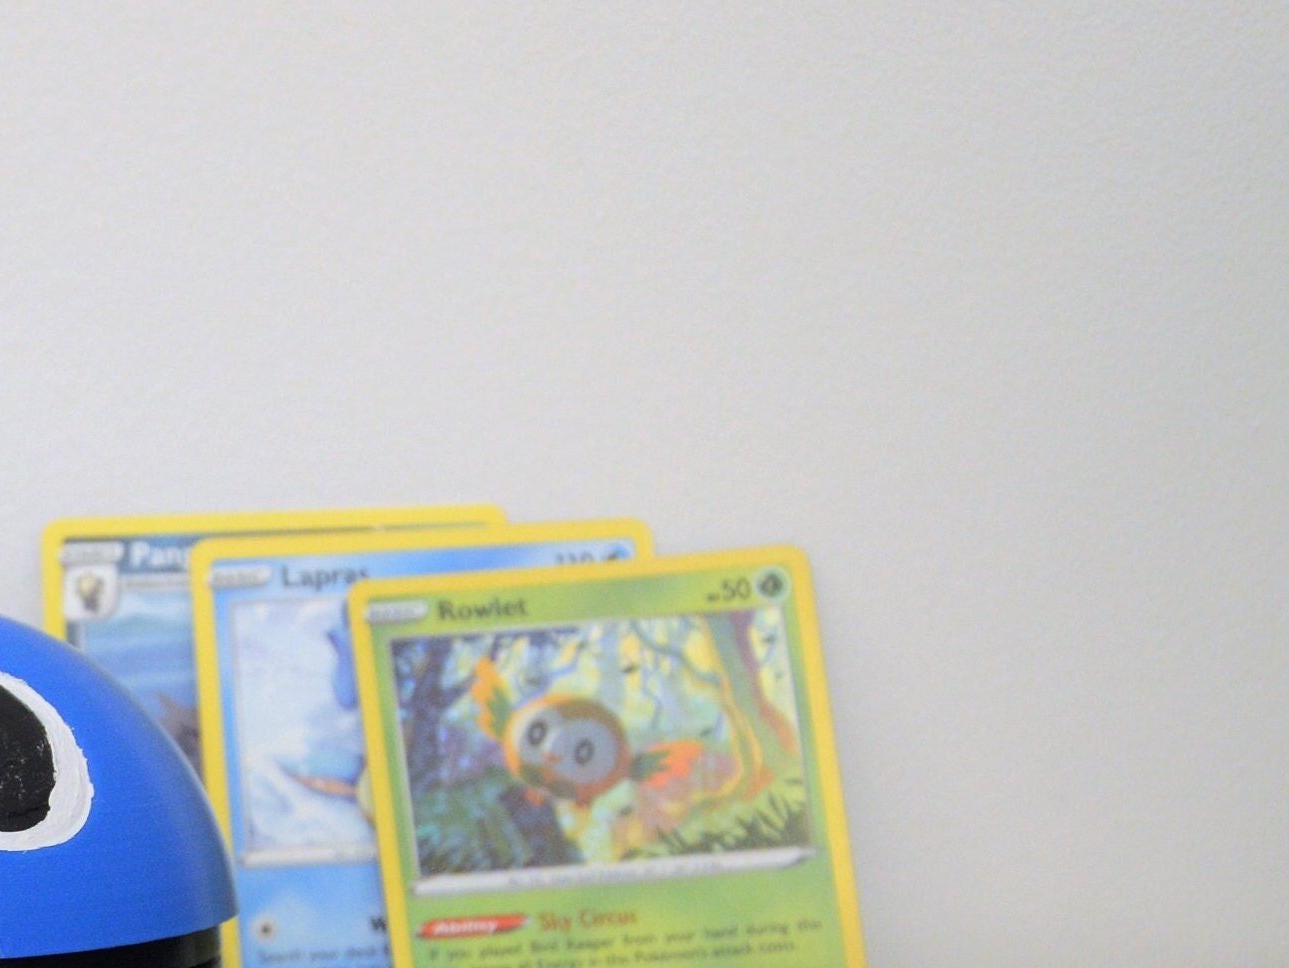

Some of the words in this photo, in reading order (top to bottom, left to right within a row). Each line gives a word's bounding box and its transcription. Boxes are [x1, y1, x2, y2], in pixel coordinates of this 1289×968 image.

[282, 566, 371, 591] Lapras
[719, 577, 751, 601] 50
[438, 596, 528, 620] Rowlet
[433, 919, 498, 937] Ability
[539, 911, 572, 933] Sky
[578, 908, 638, 928] Circus
